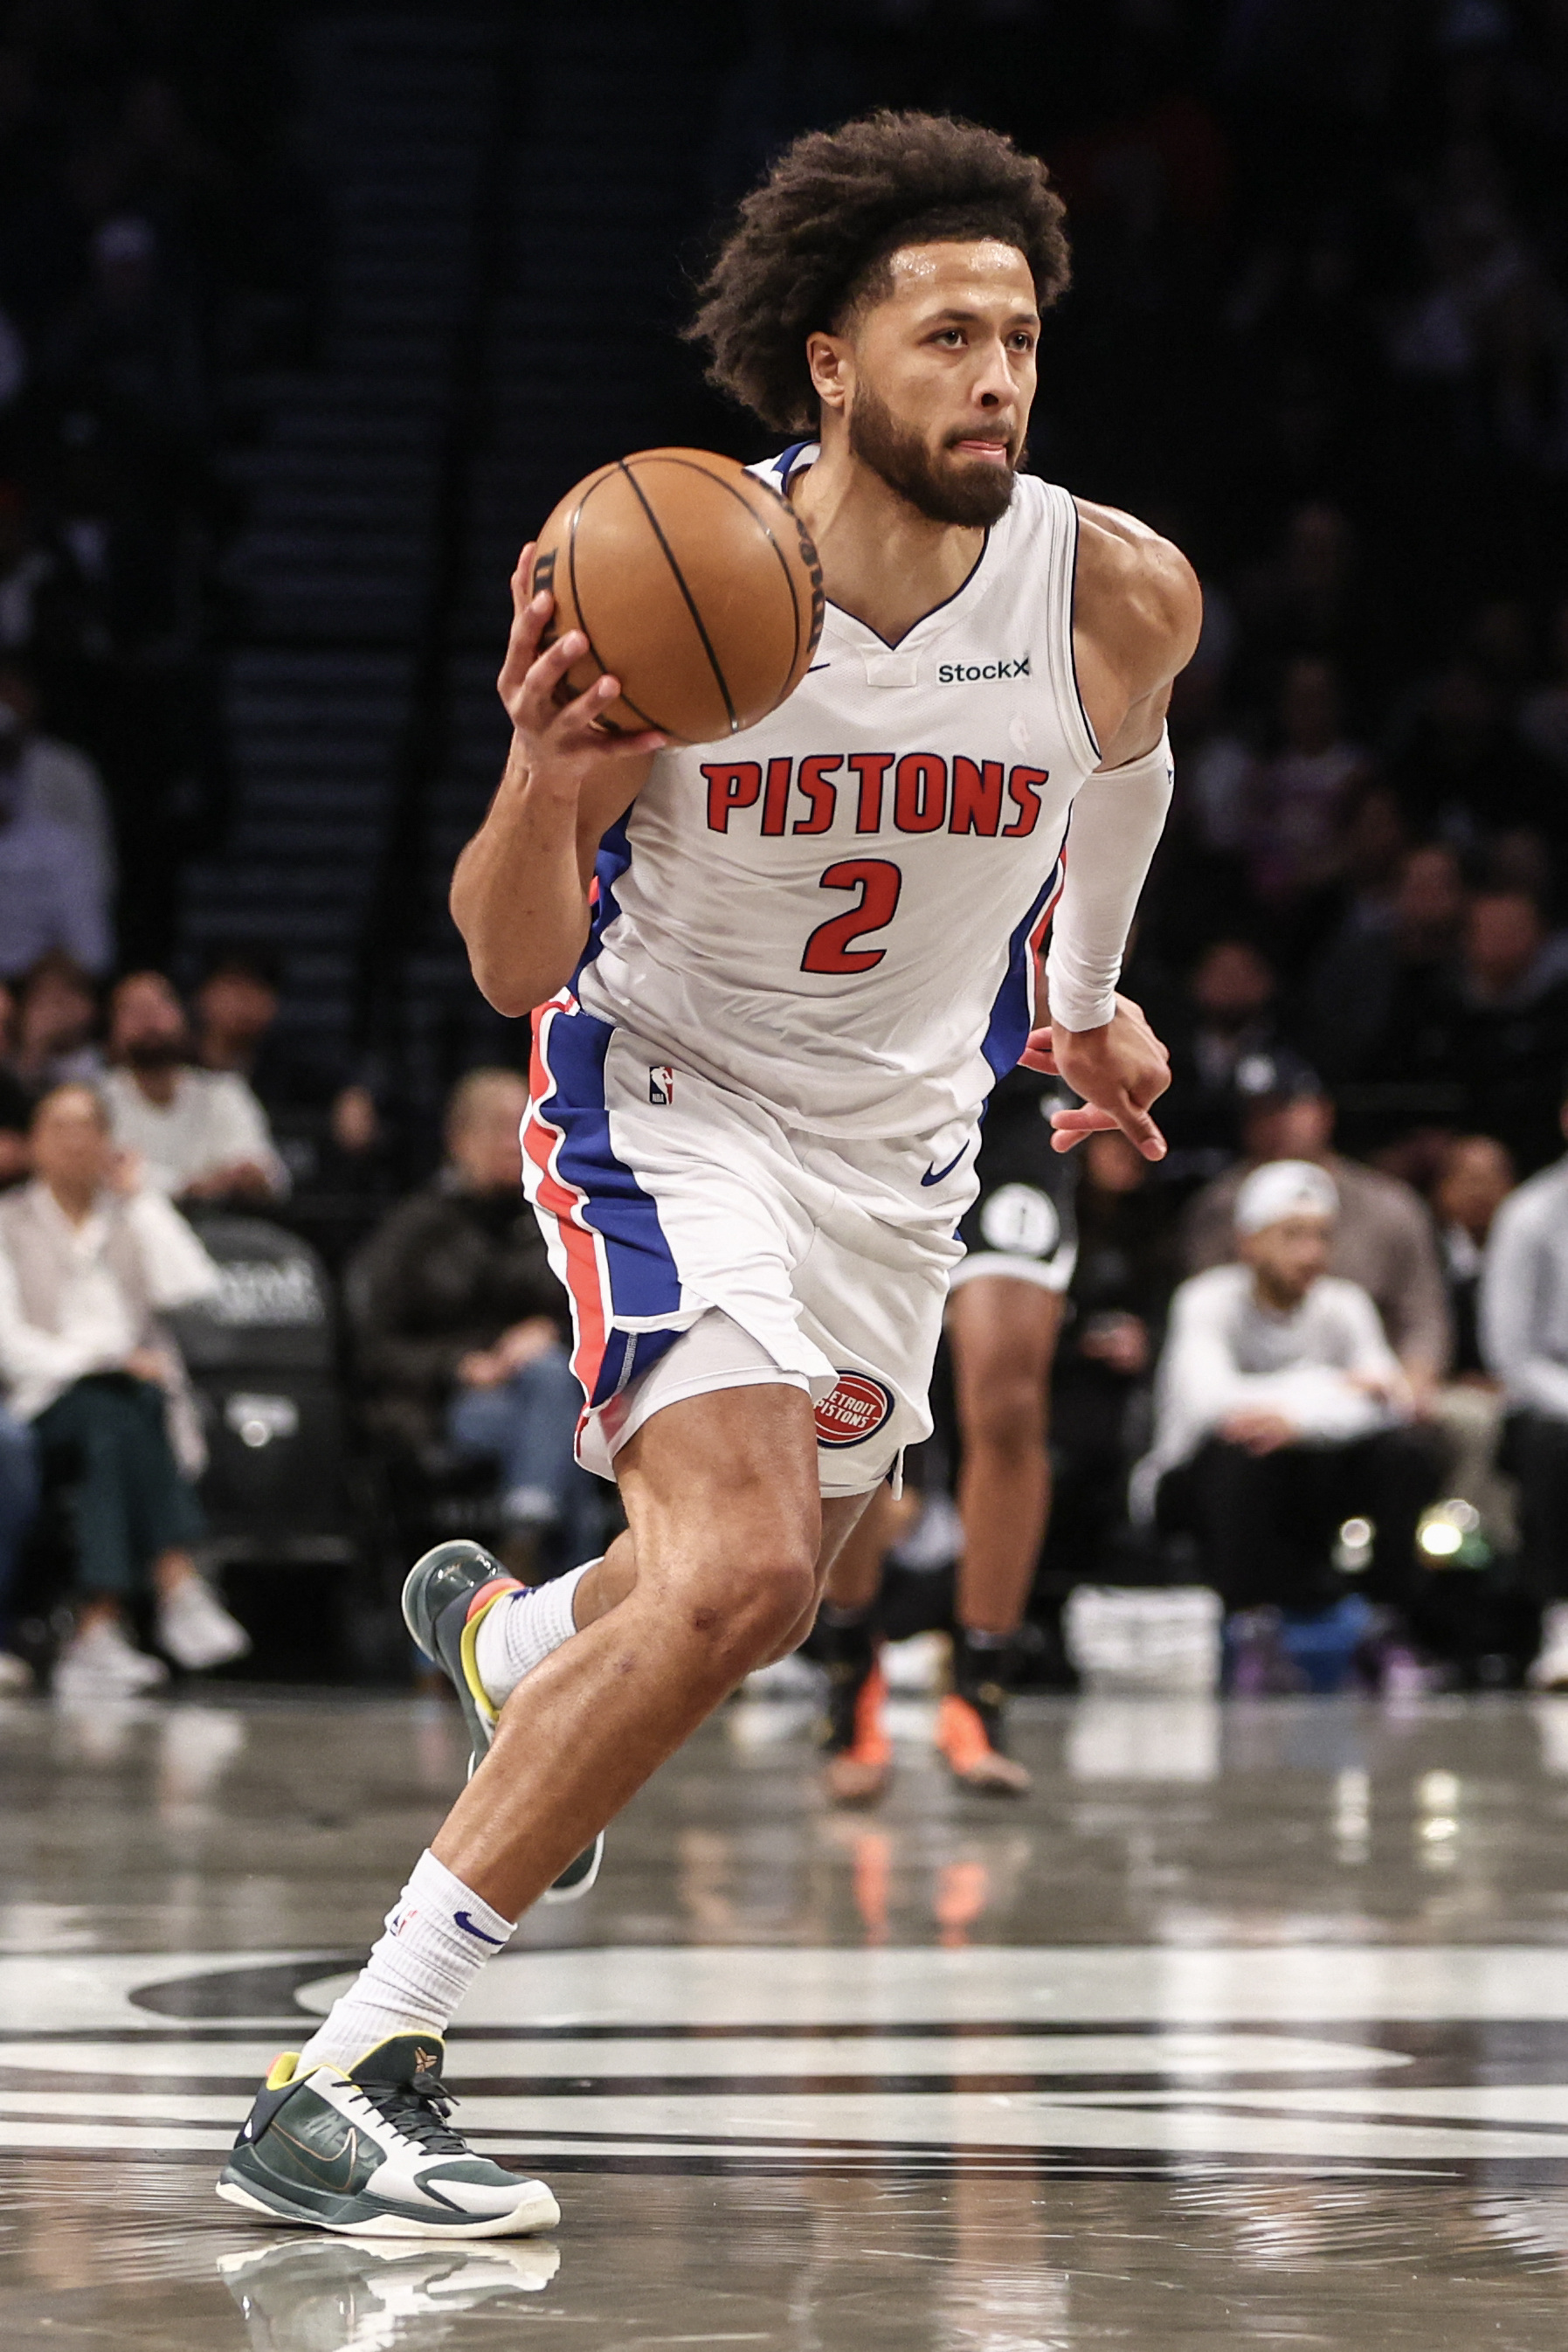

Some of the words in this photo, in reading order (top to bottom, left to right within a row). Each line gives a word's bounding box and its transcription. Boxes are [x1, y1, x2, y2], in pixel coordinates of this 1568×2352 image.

[939, 657, 1029, 682] StockX
[700, 752, 1049, 837] PISTONS
[799, 858, 902, 975] 2
[812, 1398, 870, 1428] PISTONS
[826, 1390, 877, 1416] ETROIT
